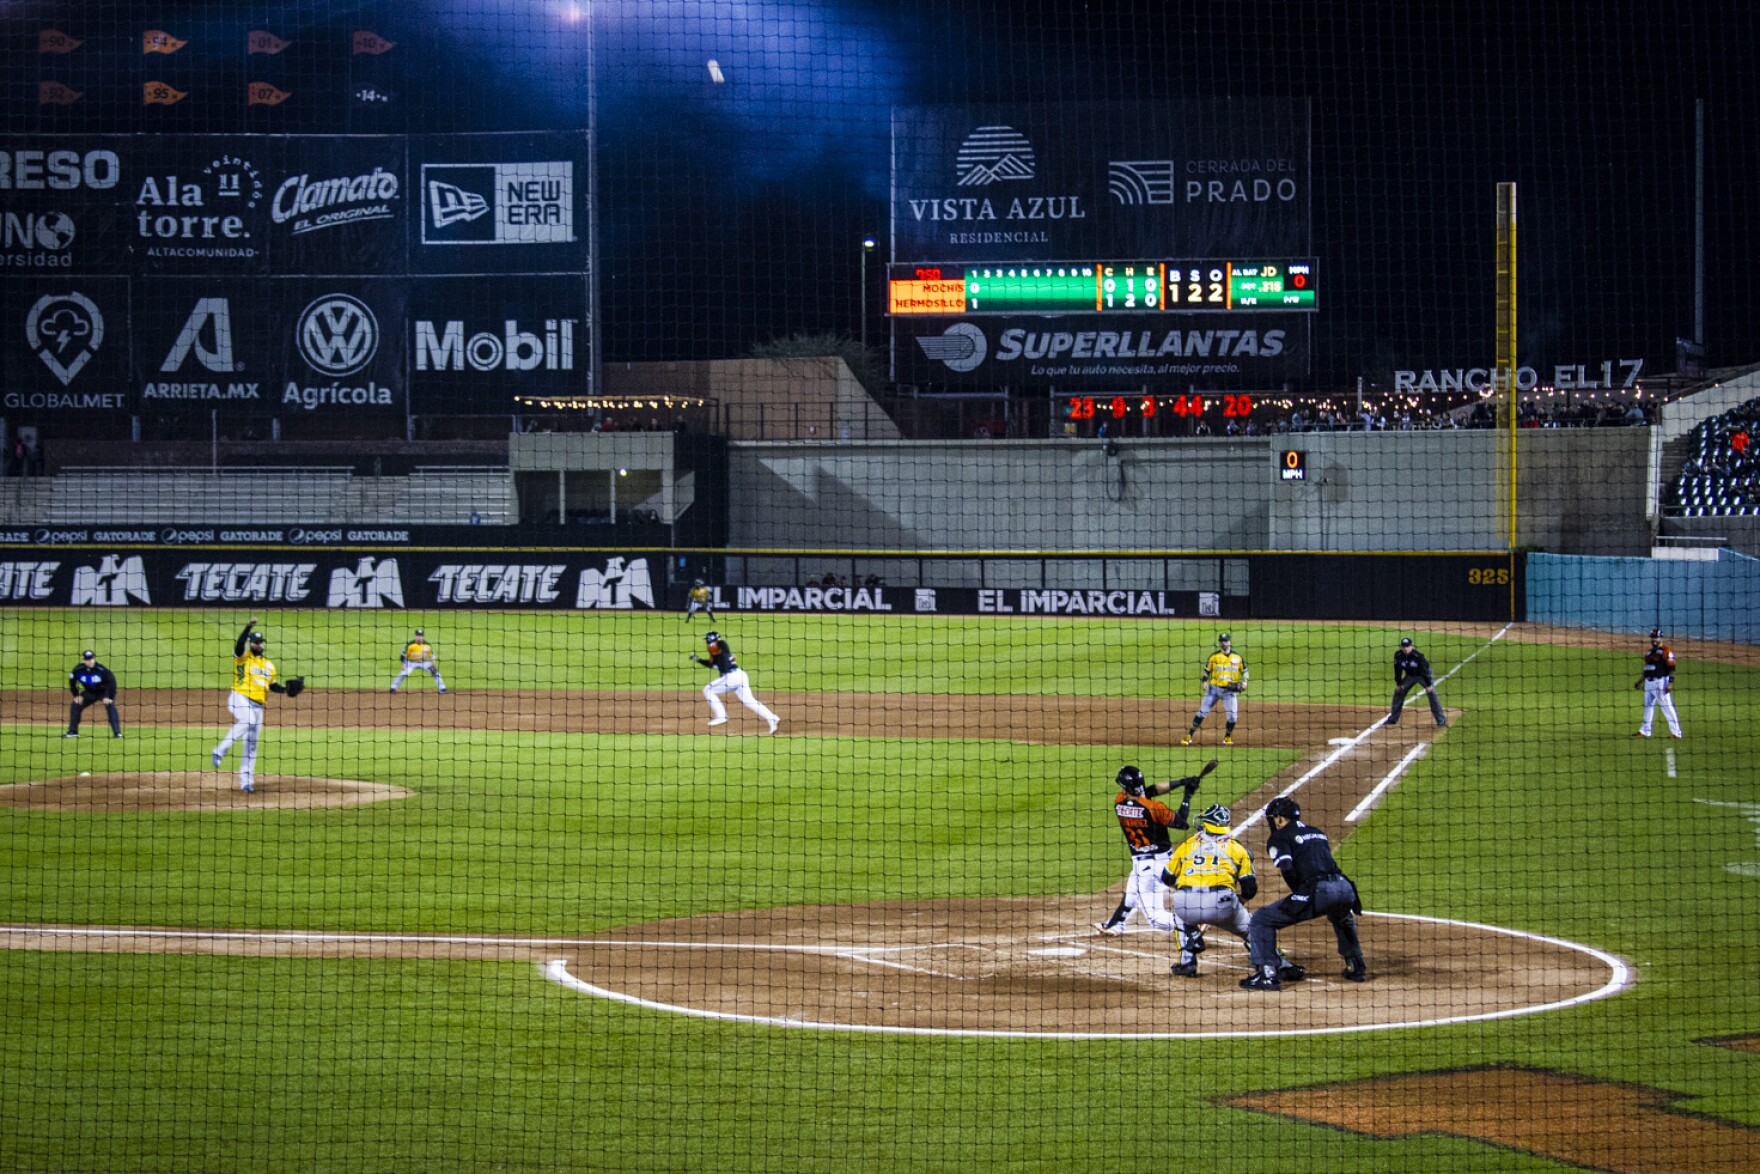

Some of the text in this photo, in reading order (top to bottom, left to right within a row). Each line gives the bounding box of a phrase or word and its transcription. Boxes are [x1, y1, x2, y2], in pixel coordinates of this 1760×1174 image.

[152, 36, 168, 47] 94
[153, 87, 169, 99] 95
[258, 88, 273, 99] 07
[361, 90, 375, 101] 14
[1186, 158, 1297, 174] CERRADA DEL
[136, 175, 205, 207] Ala
[271, 167, 399, 224] Clamato
[508, 180, 561, 202] NEW
[1186, 178, 1297, 203] PRADO
[293, 204, 391, 231] EL ORIGINAL
[508, 203, 561, 225] ERA
[909, 196, 1086, 222] VISTA AZUL
[137, 209, 251, 239] torre.
[950, 231, 1049, 244] RESIDENCIAL
[971, 269, 978, 278] 1
[983, 268, 991, 278] 2
[996, 268, 1003, 278] 3
[1008, 268, 1016, 278] 4
[1021, 268, 1028, 278] 5
[1033, 268, 1041, 278] 6
[1046, 268, 1053, 278] 7
[1058, 268, 1066, 278] 8
[1070, 268, 1078, 277] 9
[1104, 267, 1114, 277] C
[1125, 267, 1134, 277] H
[1169, 269, 1223, 283] B S O
[1260, 265, 1278, 277] JD
[1288, 265, 1310, 275] MPH
[923, 278, 1158, 294] MOCHIS 0 0 1 0
[1293, 273, 1306, 289] 0
[895, 293, 1158, 310] HERMOSILLO 1 1 2 0
[1168, 283, 1224, 303] 1 2 2
[415, 319, 574, 372] Mobil
[995, 328, 1286, 361] SUPERLLANTAS
[1031, 364, 1045, 375] Lo
[1046, 366, 1068, 378] que
[1068, 364, 1080, 375] tu
[1081, 365, 1108, 375] auto
[1157, 363, 1169, 374] al
[1169, 362, 1201, 376] mejor
[1201, 362, 1241, 376] precio.
[1394, 366, 1539, 394] RANCHO
[144, 382, 260, 400] ARRIETA.MX
[283, 381, 393, 410] Agrícola
[4, 392, 126, 409] GLOBALMET
[1070, 396, 1096, 419] 23
[1111, 396, 1126, 419] 9
[1172, 394, 1204, 418] 44
[1223, 394, 1253, 417] 20
[1286, 451, 1298, 469] 0
[1282, 468, 1303, 480] MPH
[51, 530, 88, 544] pepsi
[93, 532, 157, 542] GATORADE
[178, 530, 214, 544] pepsi
[219, 531, 284, 542] GATORADE
[305, 530, 342, 544] pepsi
[347, 531, 409, 542] GATORADE
[175, 562, 318, 601] TECATE
[427, 564, 567, 603] TECATE
[1468, 568, 1509, 585] 325
[738, 586, 893, 611] IMPARCIAL
[977, 589, 1013, 612] EL
[1020, 589, 1175, 615] IMPARCIAL
